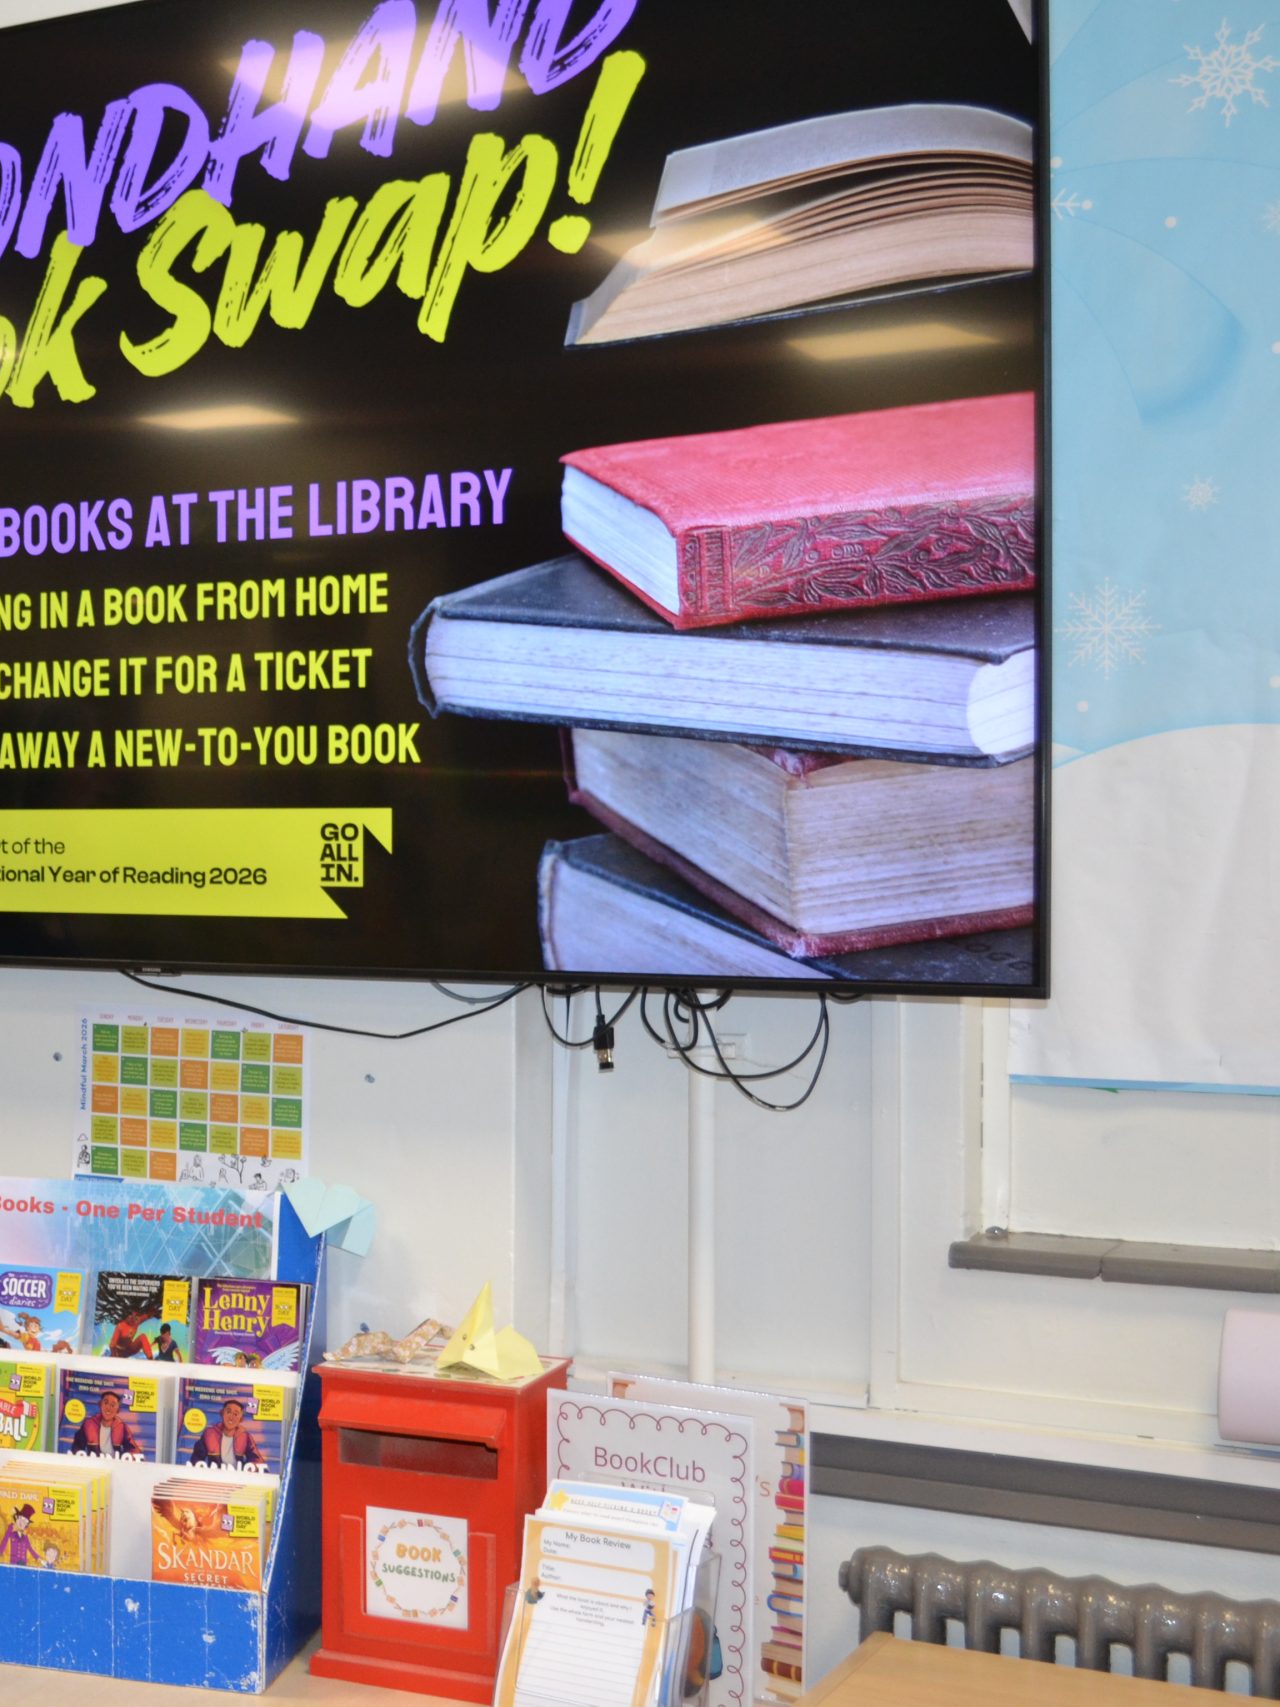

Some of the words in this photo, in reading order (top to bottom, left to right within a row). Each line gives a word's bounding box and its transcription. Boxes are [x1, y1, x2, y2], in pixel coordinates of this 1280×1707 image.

[120, 50, 646, 376] Swap!
[144, 493, 198, 548] AT
[216, 486, 294, 543] THE
[309, 468, 513, 536] LIBRARY
[39, 592, 68, 629] IN
[76, 590, 96, 628] A
[104, 584, 188, 626] BOOK
[197, 578, 287, 621] FROM
[295, 572, 388, 616] HOME
[119, 658, 145, 695] IT
[154, 656, 218, 694] FOR
[226, 654, 247, 692] A
[254, 648, 372, 690] TICKET
[0, 731, 81, 769] AWAY
[88, 731, 107, 768] A
[115, 726, 318, 767] NEW-TO-YOU
[328, 723, 421, 764] BOOK
[321, 823, 359, 841] GO
[11, 837, 31, 854] of
[33, 838, 65, 855] the
[320, 844, 359, 862] ALL
[48, 867, 96, 883] Year
[99, 867, 120, 883] of
[123, 867, 206, 888] Reading
[209, 867, 267, 886] 2026
[321, 864, 359, 882] IN.
[76, 1201, 119, 1218] One
[128, 1204, 165, 1222] Per
[173, 1206, 263, 1229] Student
[1, 1278, 46, 1298] SOCCER
[9, 1296, 36, 1307] diaries
[203, 1287, 271, 1315] Lenny
[202, 1309, 270, 1338] Henry
[594, 1446, 706, 1484] BookClub
[565, 1532, 577, 1542] My
[580, 1536, 601, 1545] Book
[603, 1538, 632, 1550] Review
[158, 1542, 258, 1577] SKANDAR
[396, 1543, 442, 1562] BOOK
[184, 1573, 229, 1584] SECRET
[382, 1563, 456, 1583] SUGGESTIONS
